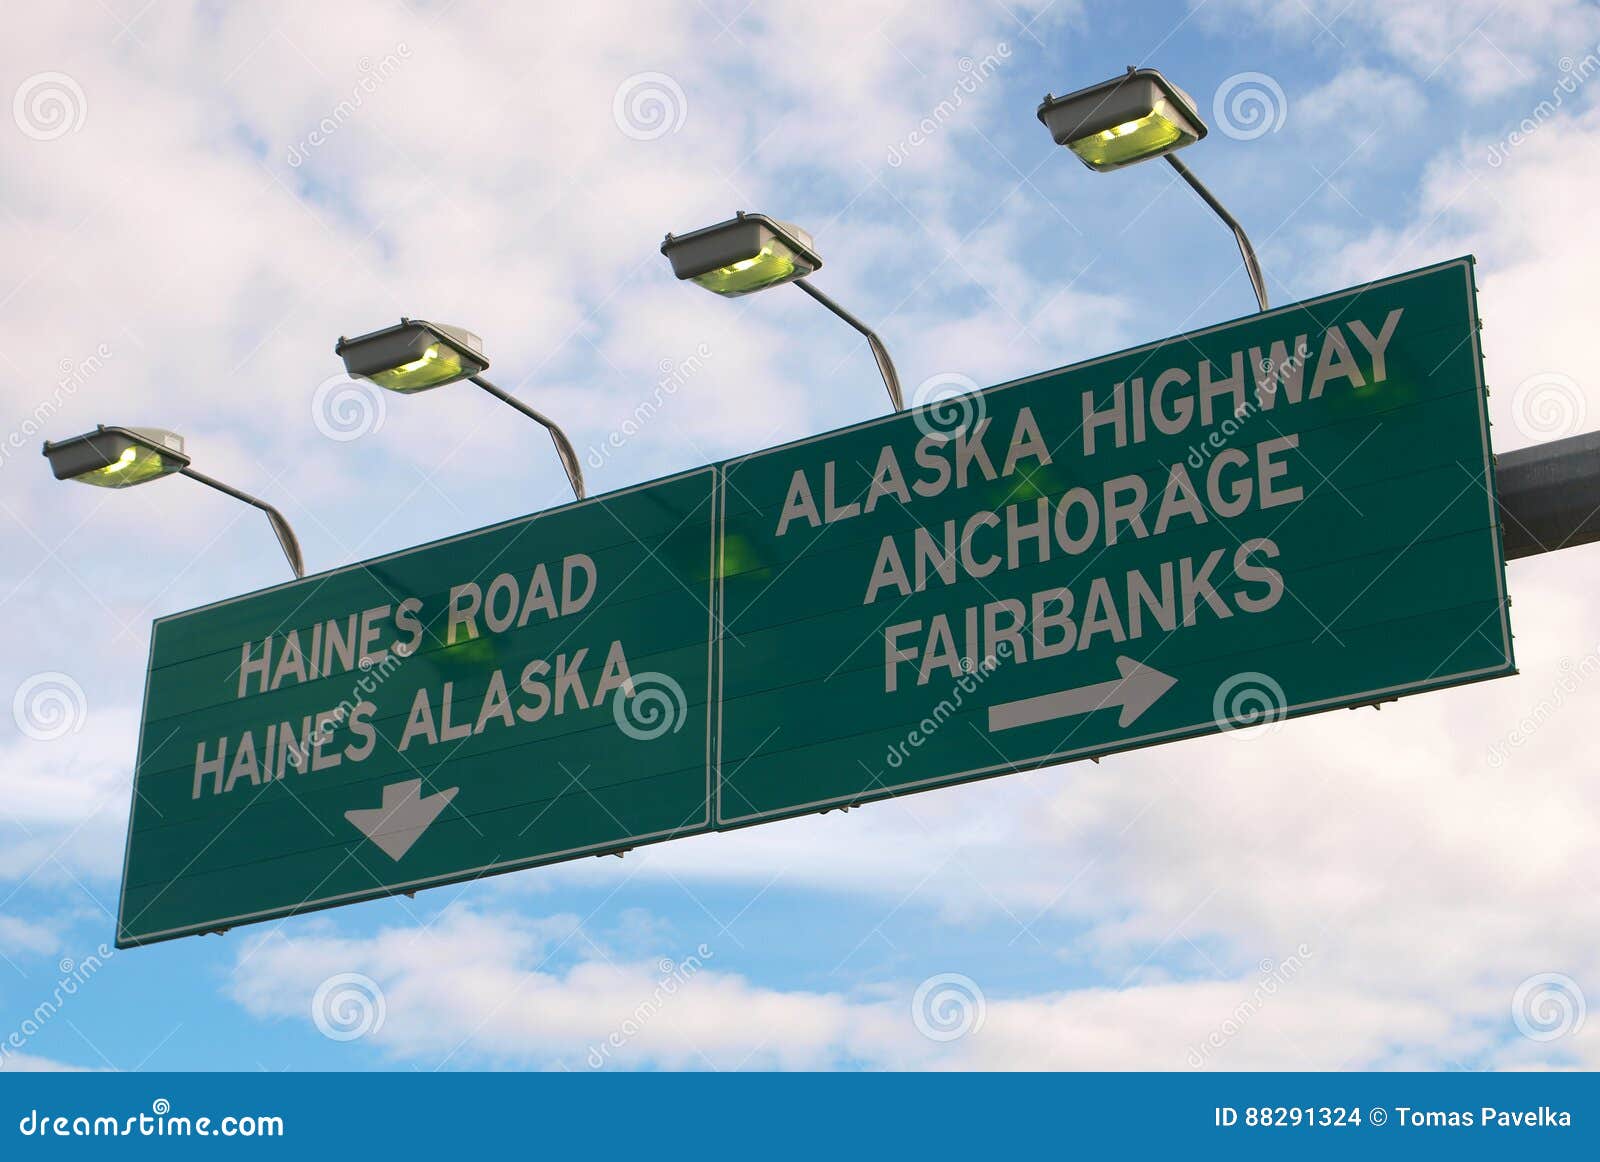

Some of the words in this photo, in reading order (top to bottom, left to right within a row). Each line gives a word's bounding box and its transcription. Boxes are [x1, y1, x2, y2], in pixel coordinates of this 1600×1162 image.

[775, 407, 1053, 537] ALASKA
[1081, 308, 1405, 457] HIGHWAY
[863, 433, 1304, 605] ANCHORAGE
[237, 597, 424, 699] HAINES
[446, 553, 598, 645] ROAD
[885, 537, 1285, 693] FAIRBANKS
[192, 701, 378, 800] HAINES
[397, 640, 636, 753] ALASKA
